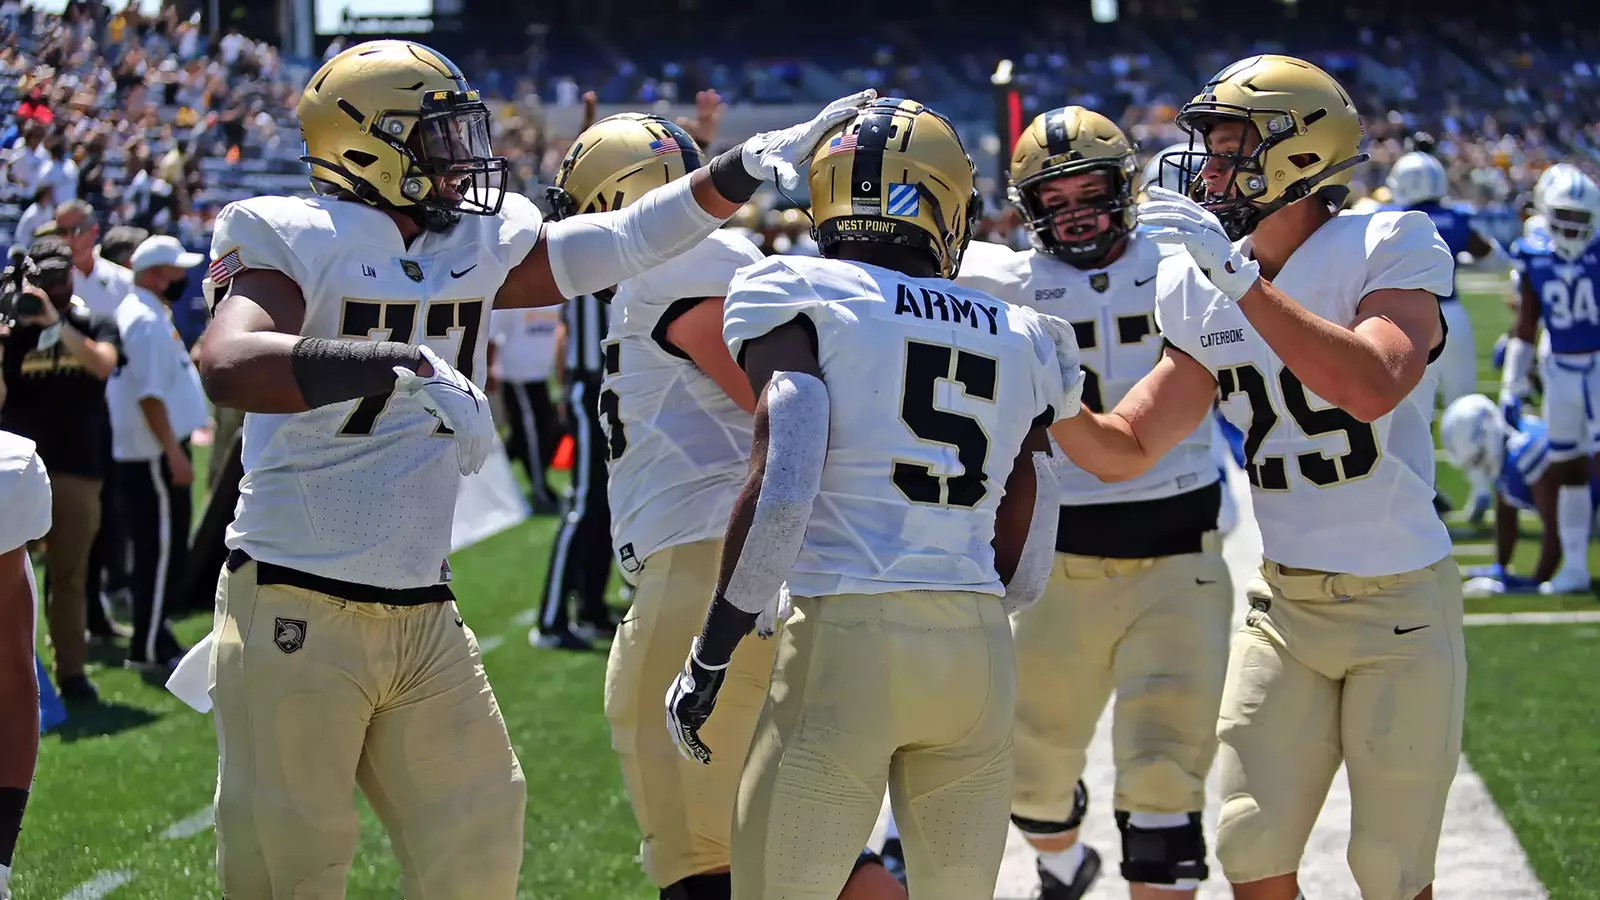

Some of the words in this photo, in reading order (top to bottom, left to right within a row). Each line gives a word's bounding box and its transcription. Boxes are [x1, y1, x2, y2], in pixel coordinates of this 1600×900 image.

[836, 219, 863, 232] WEST
[865, 220, 897, 234] POINT
[895, 283, 998, 335] ARMY
[1035, 287, 1067, 301] BISHOP
[1542, 276, 1599, 330] 34
[1200, 328, 1245, 348] CATERBONE
[335, 296, 486, 438] 77
[890, 337, 998, 510] 5
